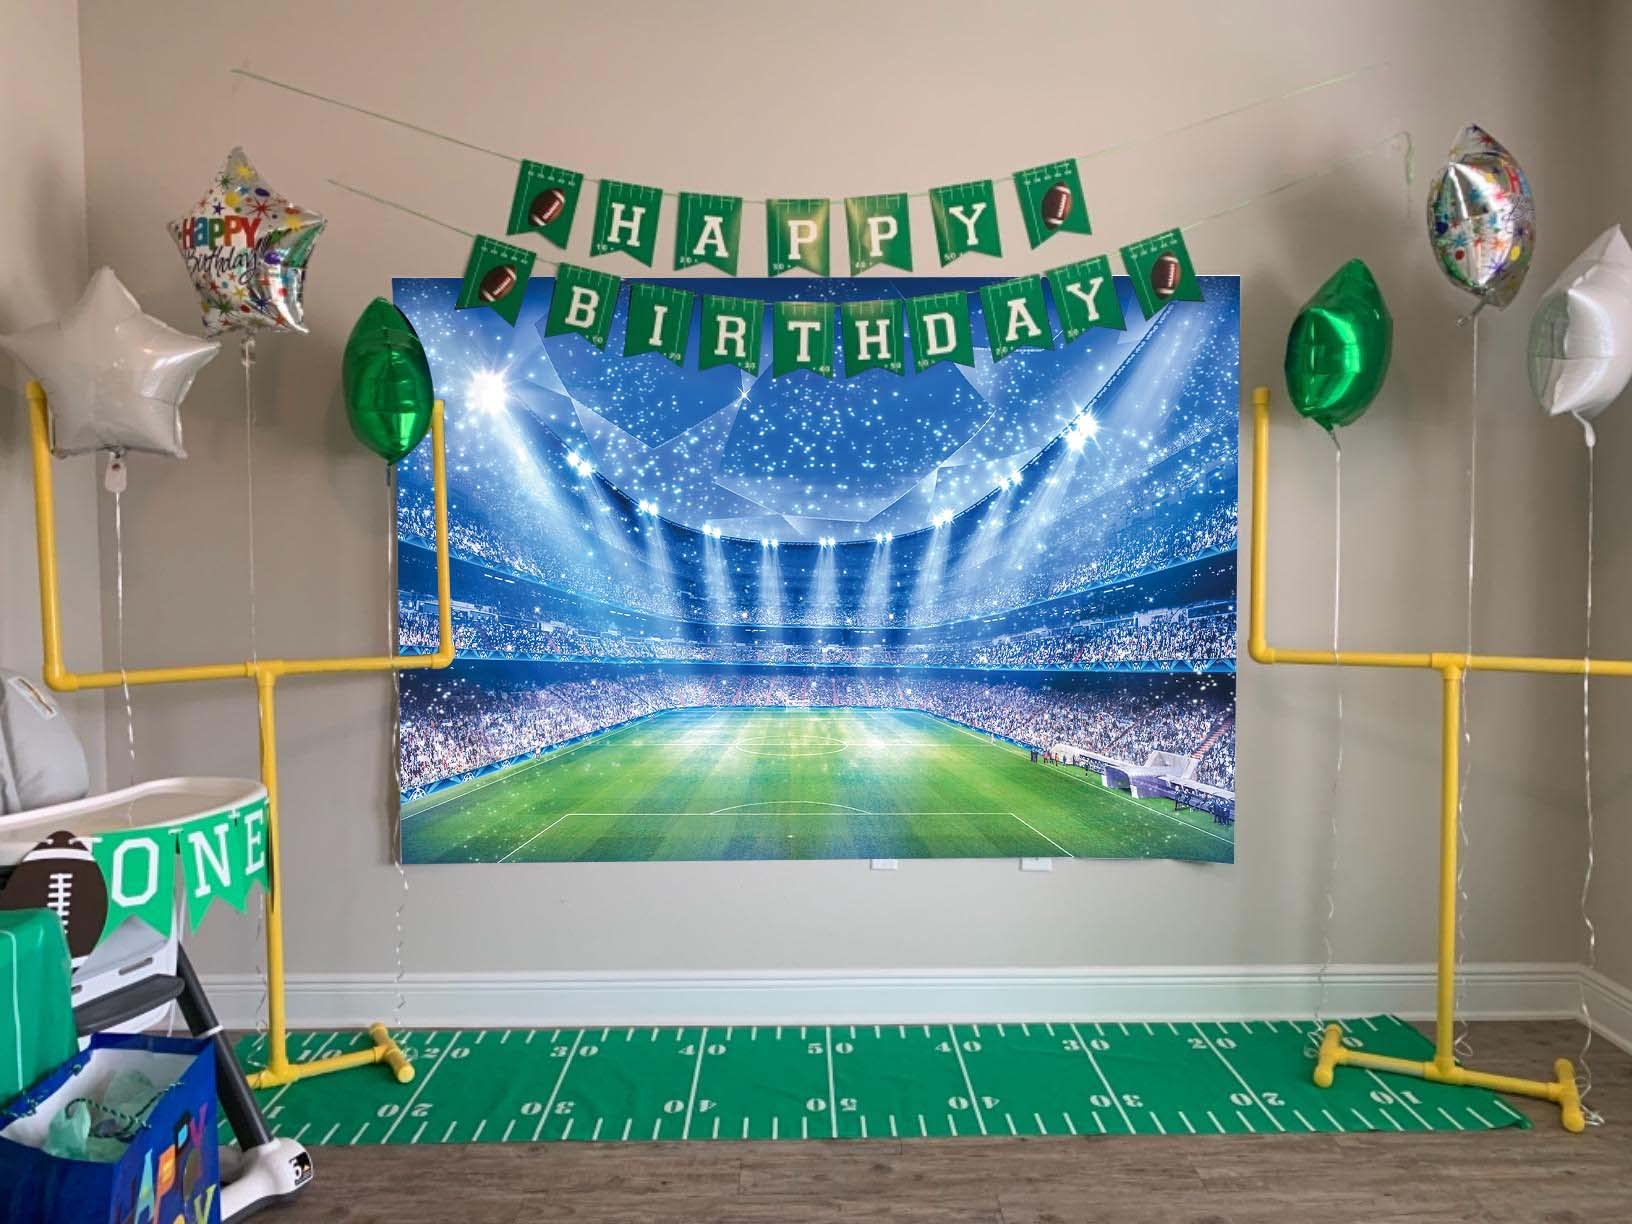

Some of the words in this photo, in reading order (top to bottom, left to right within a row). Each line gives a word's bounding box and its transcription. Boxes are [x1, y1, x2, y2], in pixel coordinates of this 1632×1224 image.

[606, 202, 986, 260] HAPPY
[565, 277, 1104, 362] BIRTHDAY
[112, 809, 265, 907] ONE
[421, 1048, 470, 1059] 20
[551, 1046, 598, 1057] 30
[678, 1044, 726, 1056] 40
[807, 1042, 853, 1054] 50
[936, 1041, 982, 1053] 40
[1063, 1039, 1110, 1050] 30
[1188, 1038, 1237, 1049] 20
[806, 1098, 857, 1112] 50
[949, 1096, 1000, 1109] 40
[1090, 1095, 1143, 1108] 30
[1230, 1092, 1286, 1107] 20
[1370, 1090, 1422, 1105] 10
[377, 1103, 432, 1117] 20
[521, 1101, 576, 1115] 30
[664, 1099, 717, 1114] 40
